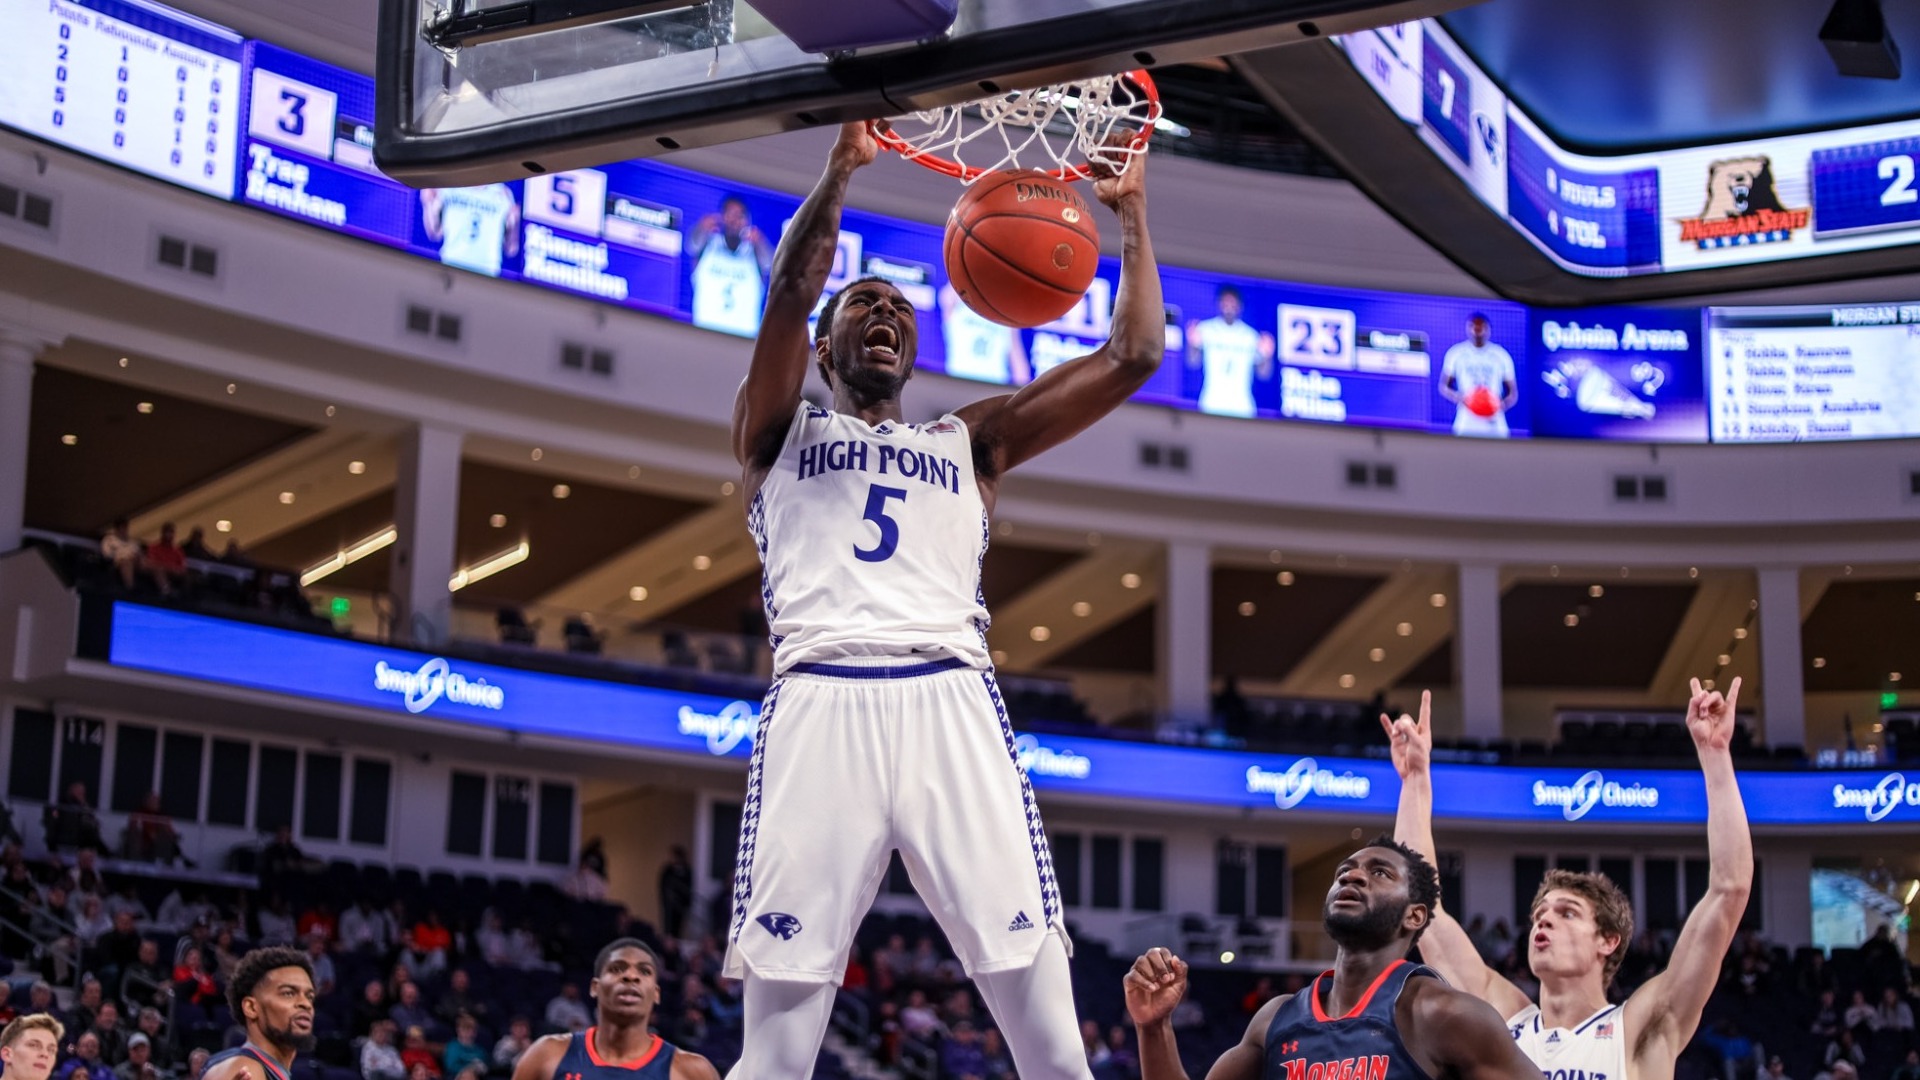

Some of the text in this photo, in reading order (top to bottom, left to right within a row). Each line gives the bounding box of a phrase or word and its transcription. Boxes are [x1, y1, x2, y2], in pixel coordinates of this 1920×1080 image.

[60, 23, 70, 39] 0
[58, 44, 127, 61] 2 1
[57, 66, 67, 82] 0
[118, 67, 128, 82] 0
[117, 87, 127, 103] 0
[1438, 68, 1456, 120] 7
[53, 110, 63, 126] 0
[115, 108, 125, 124] 0
[278, 91, 306, 136] 3
[114, 132, 124, 148] 0
[1877, 155, 1918, 207] 2
[551, 175, 574, 215] 5
[1562, 216, 1606, 249] TOL
[1292, 319, 1342, 354] 23
[798, 440, 960, 495] HIGH POINT
[853, 483, 907, 562] 5
[1602, 781, 1659, 808] Choice
[1833, 784, 1889, 808] Smart
[1008, 921, 1035, 932] adidas
[1280, 1055, 1390, 1080] MORGAN
